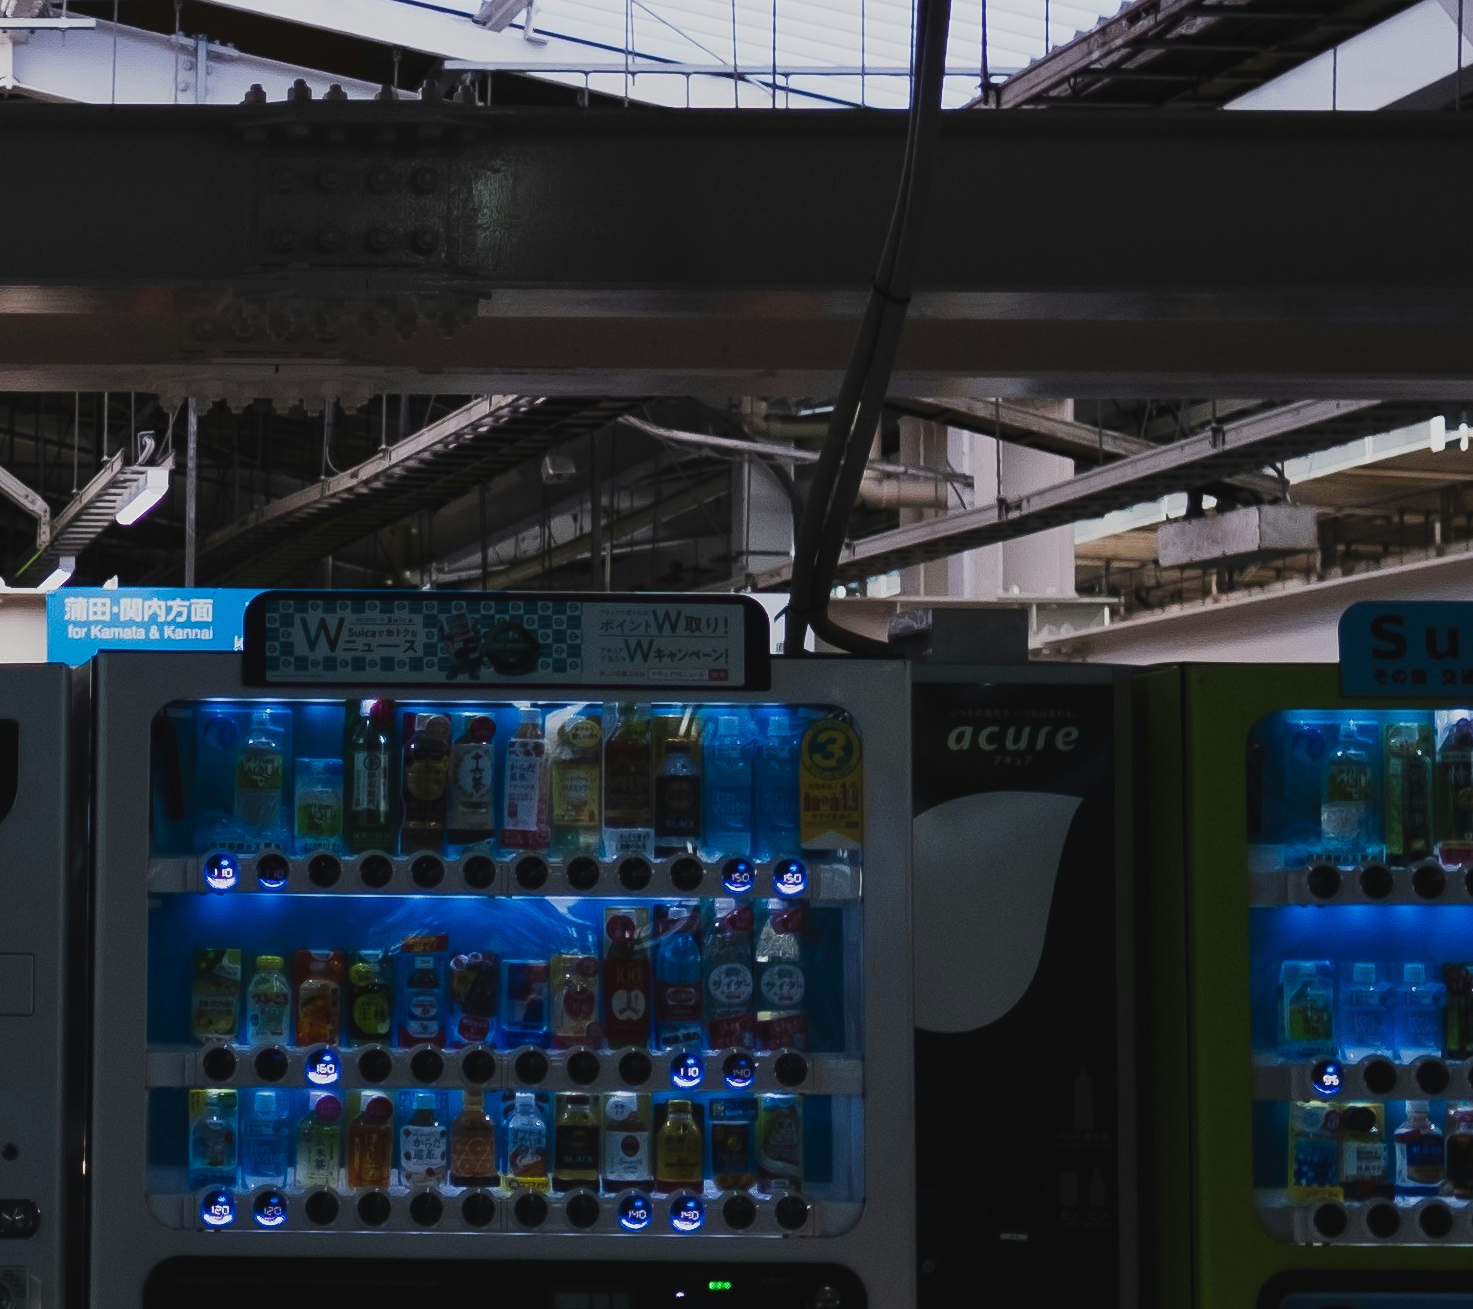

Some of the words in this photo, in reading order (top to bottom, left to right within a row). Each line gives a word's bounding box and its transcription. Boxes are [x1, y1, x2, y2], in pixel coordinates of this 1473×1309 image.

[64, 598, 214, 623] 蒲田・関内方面
[67, 625, 87, 639] for
[90, 625, 146, 640] Kamata
[148, 625, 160, 640] &
[163, 625, 214, 640] Kannai
[300, 616, 345, 653] W
[342, 640, 417, 654] ニュース
[1374, 669, 1429, 685] その他
[946, 725, 1080, 752] acure
[812, 729, 848, 769] 3
[214, 867, 234, 879] 110
[731, 873, 750, 884] 150
[680, 1066, 700, 1078] 110
[563, 1154, 596, 1165] BLACK
[263, 1206, 284, 1217] 120
